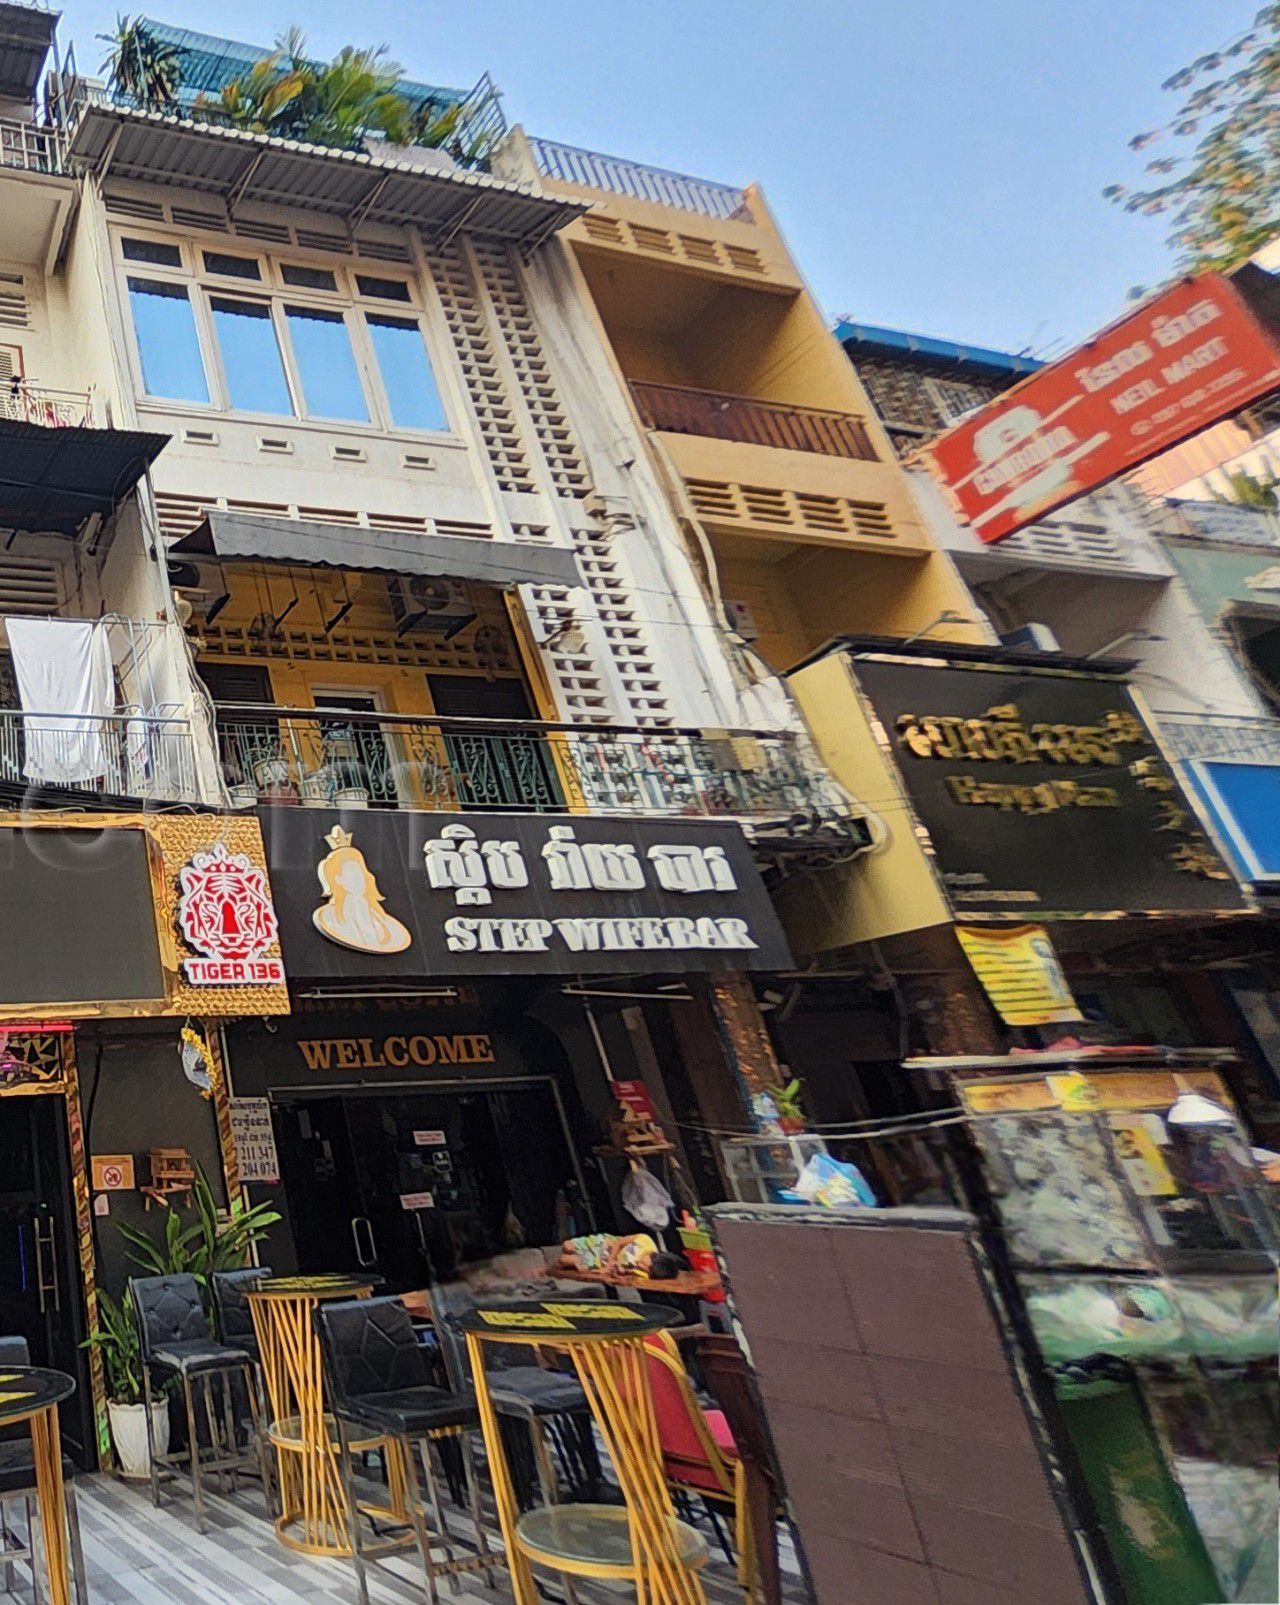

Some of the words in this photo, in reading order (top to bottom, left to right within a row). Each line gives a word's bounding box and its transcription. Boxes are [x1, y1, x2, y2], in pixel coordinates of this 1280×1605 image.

[444, 916, 554, 952] STEP
[551, 917, 671, 952] WIFE
[661, 917, 760, 950] BAR
[189, 962, 245, 980] TIGER
[248, 962, 281, 980] 136
[297, 1034, 496, 1070] WELCOME
